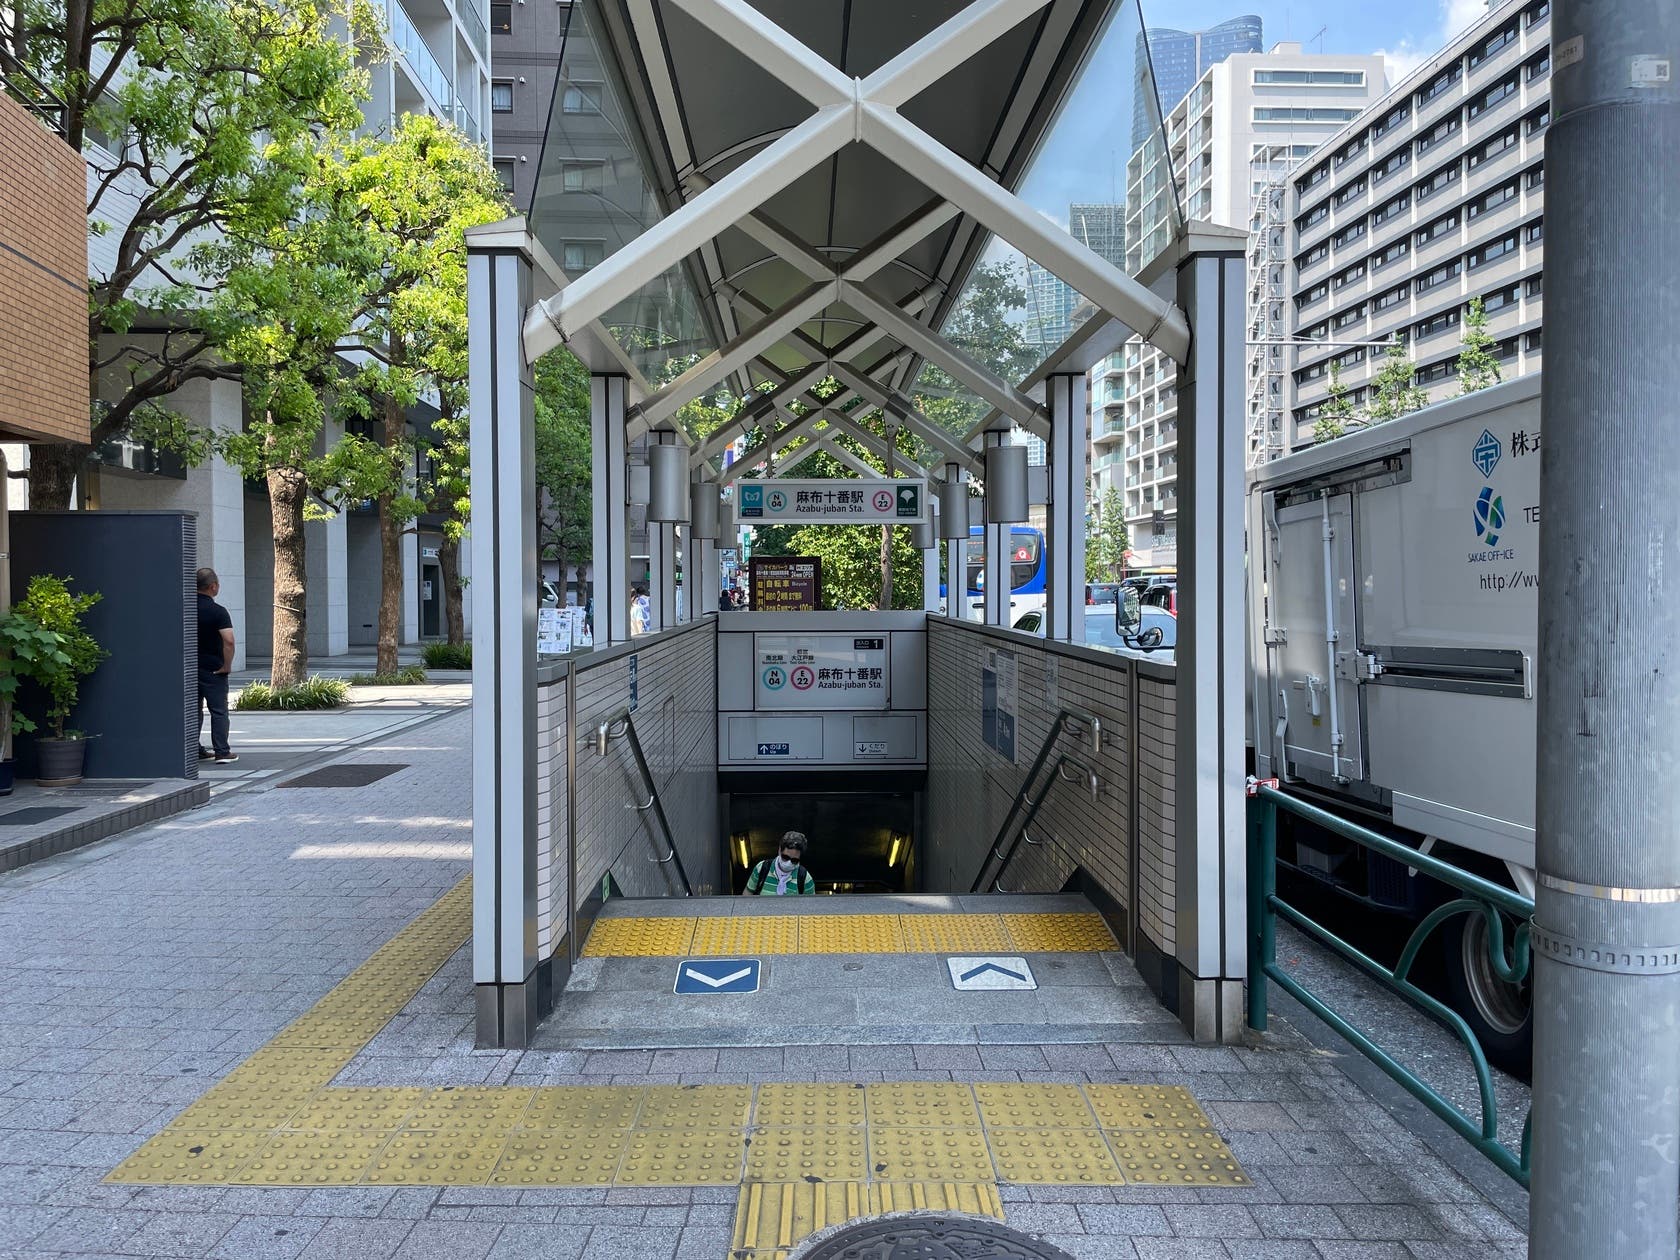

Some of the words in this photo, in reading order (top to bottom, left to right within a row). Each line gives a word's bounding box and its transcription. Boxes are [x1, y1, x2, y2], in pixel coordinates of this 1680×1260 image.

[797, 490, 864, 504] 麻布十番駅
[796, 504, 847, 514] Azabu-juban
[849, 504, 865, 513] Sta.
[1468, 551, 1487, 563] SAKAE
[873, 640, 878, 648] 1
[818, 668, 882, 680] 麻布十番駅
[818, 681, 866, 690] Azabu-juban
